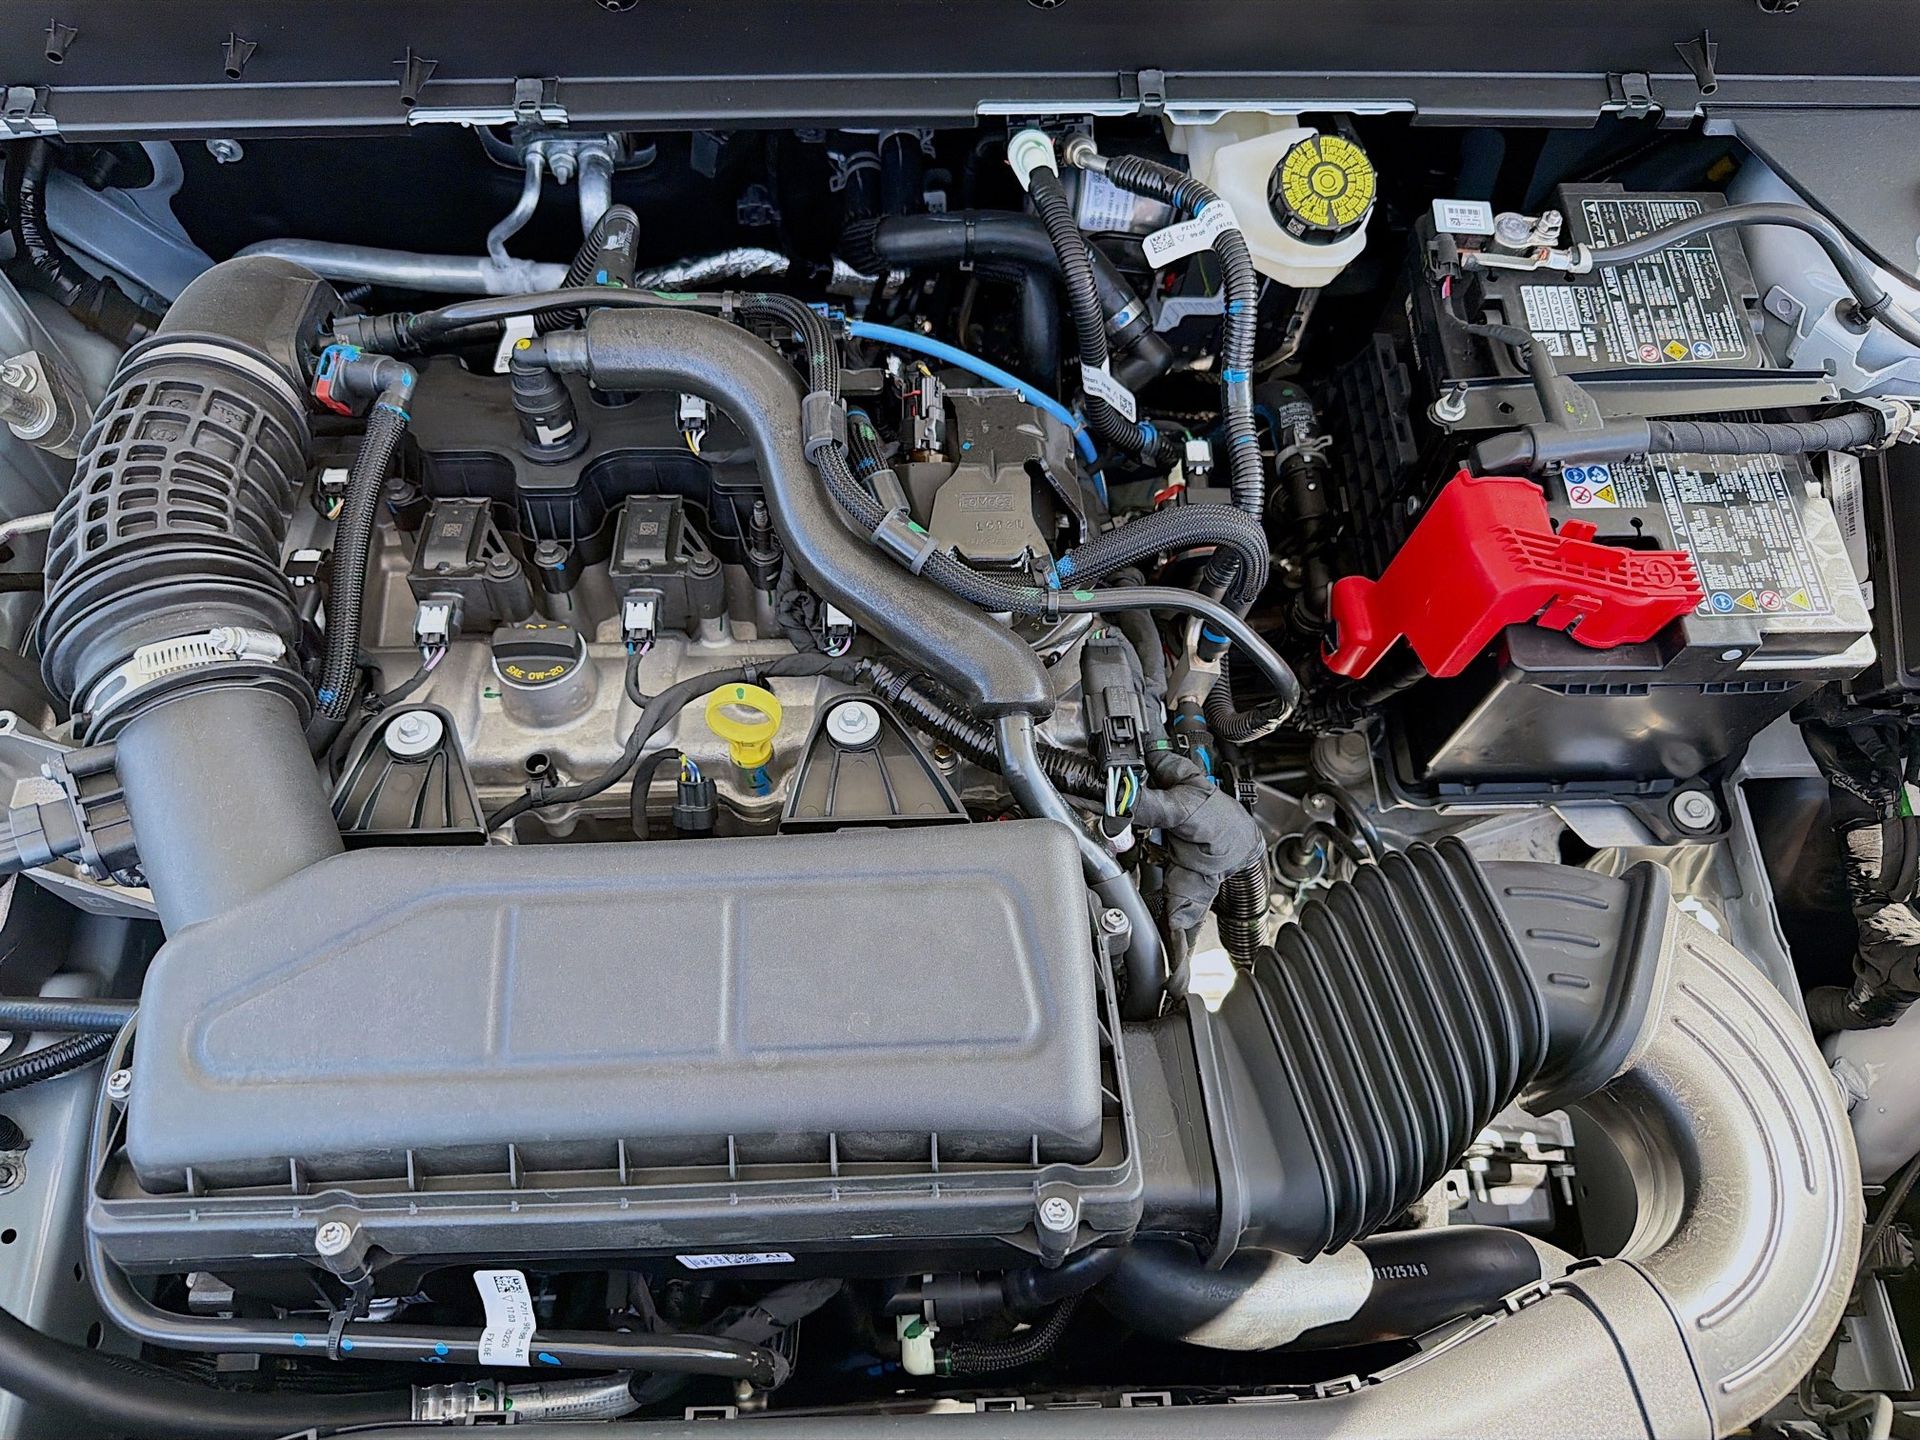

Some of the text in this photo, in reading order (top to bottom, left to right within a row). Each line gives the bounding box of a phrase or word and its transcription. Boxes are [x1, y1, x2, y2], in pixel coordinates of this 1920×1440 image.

[1549, 291, 1558, 304] C20
[1575, 287, 1593, 322] FoMoCo
[1561, 290, 1577, 327] AGM/VRLA
[1556, 317, 1564, 325] 70
[1612, 300, 1635, 350] DANGER/POISON
[1582, 325, 1597, 342] MF
[1574, 338, 1584, 350] 12V
[1656, 470, 1683, 526] PELIGRO/VENENO
[505, 665, 564, 680] SAE 0W-20
